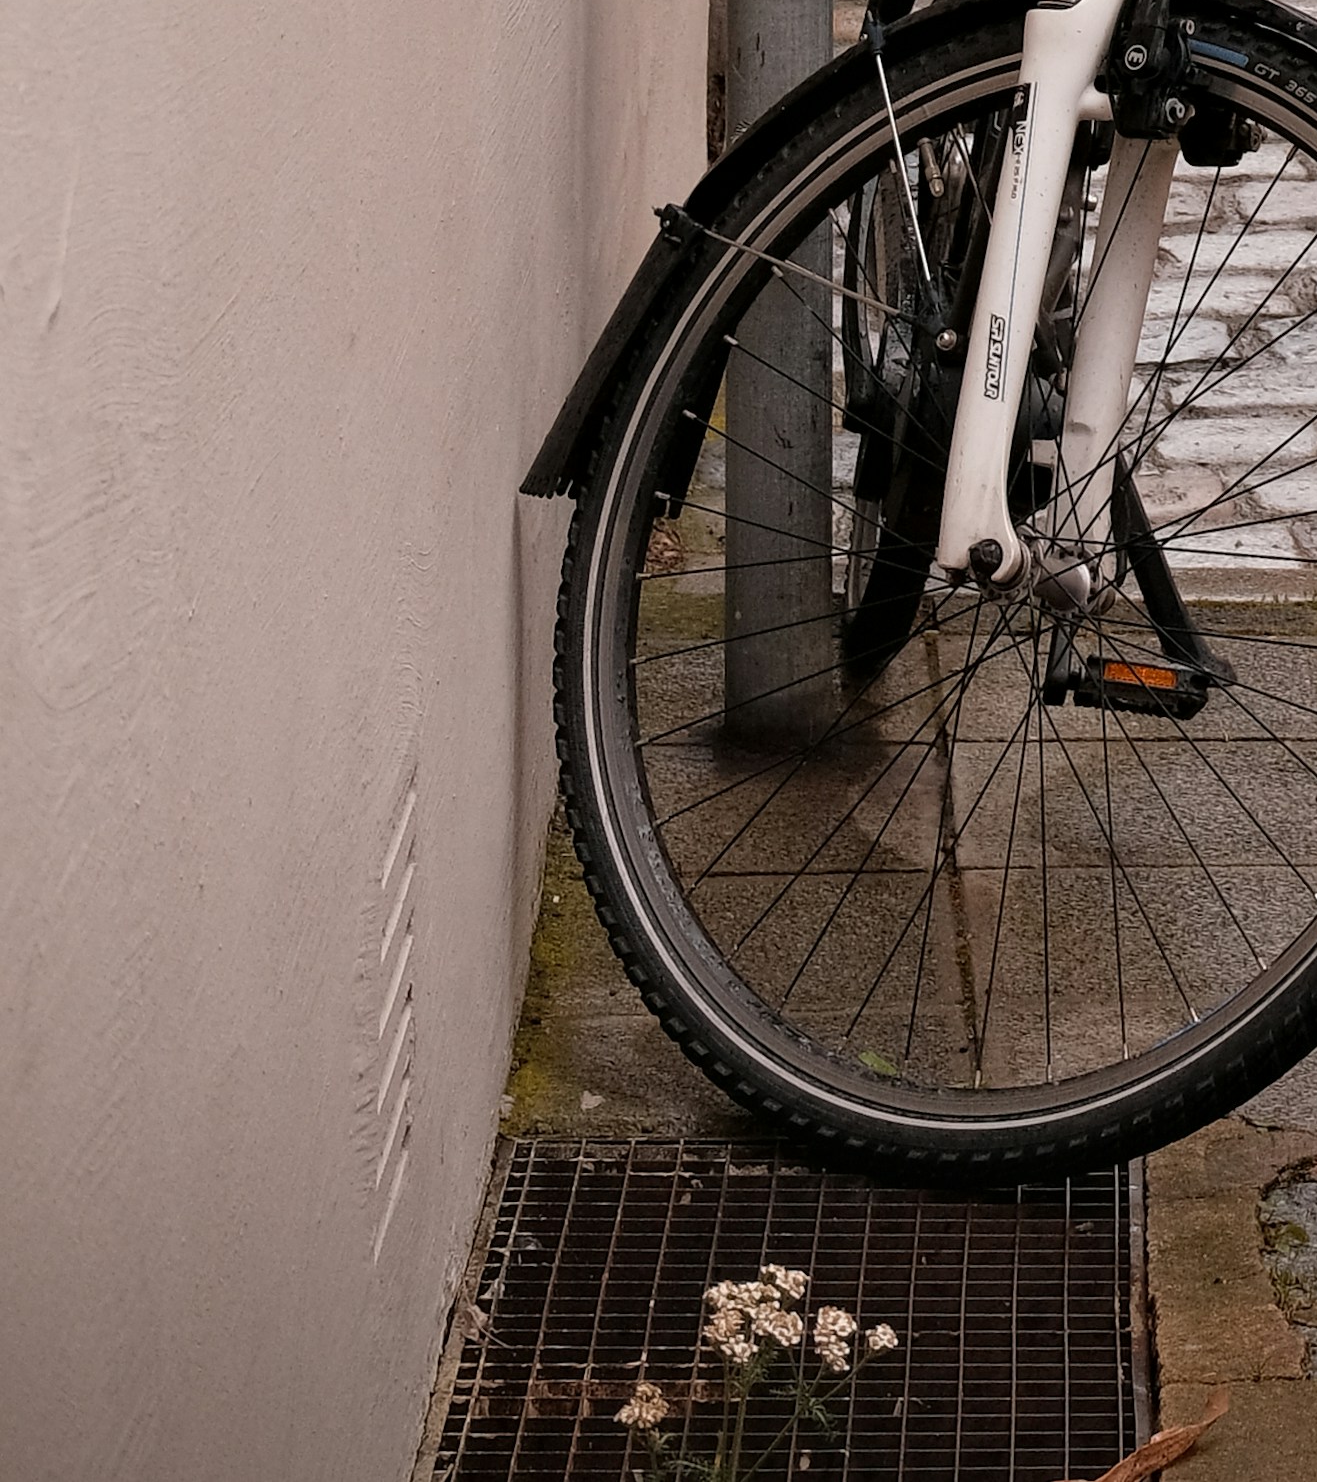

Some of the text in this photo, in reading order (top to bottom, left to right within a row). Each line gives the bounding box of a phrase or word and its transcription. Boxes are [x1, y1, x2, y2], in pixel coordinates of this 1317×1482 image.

[1254, 63, 1317, 104] GT 365
[984, 314, 1005, 400] SR SUNTOUR
